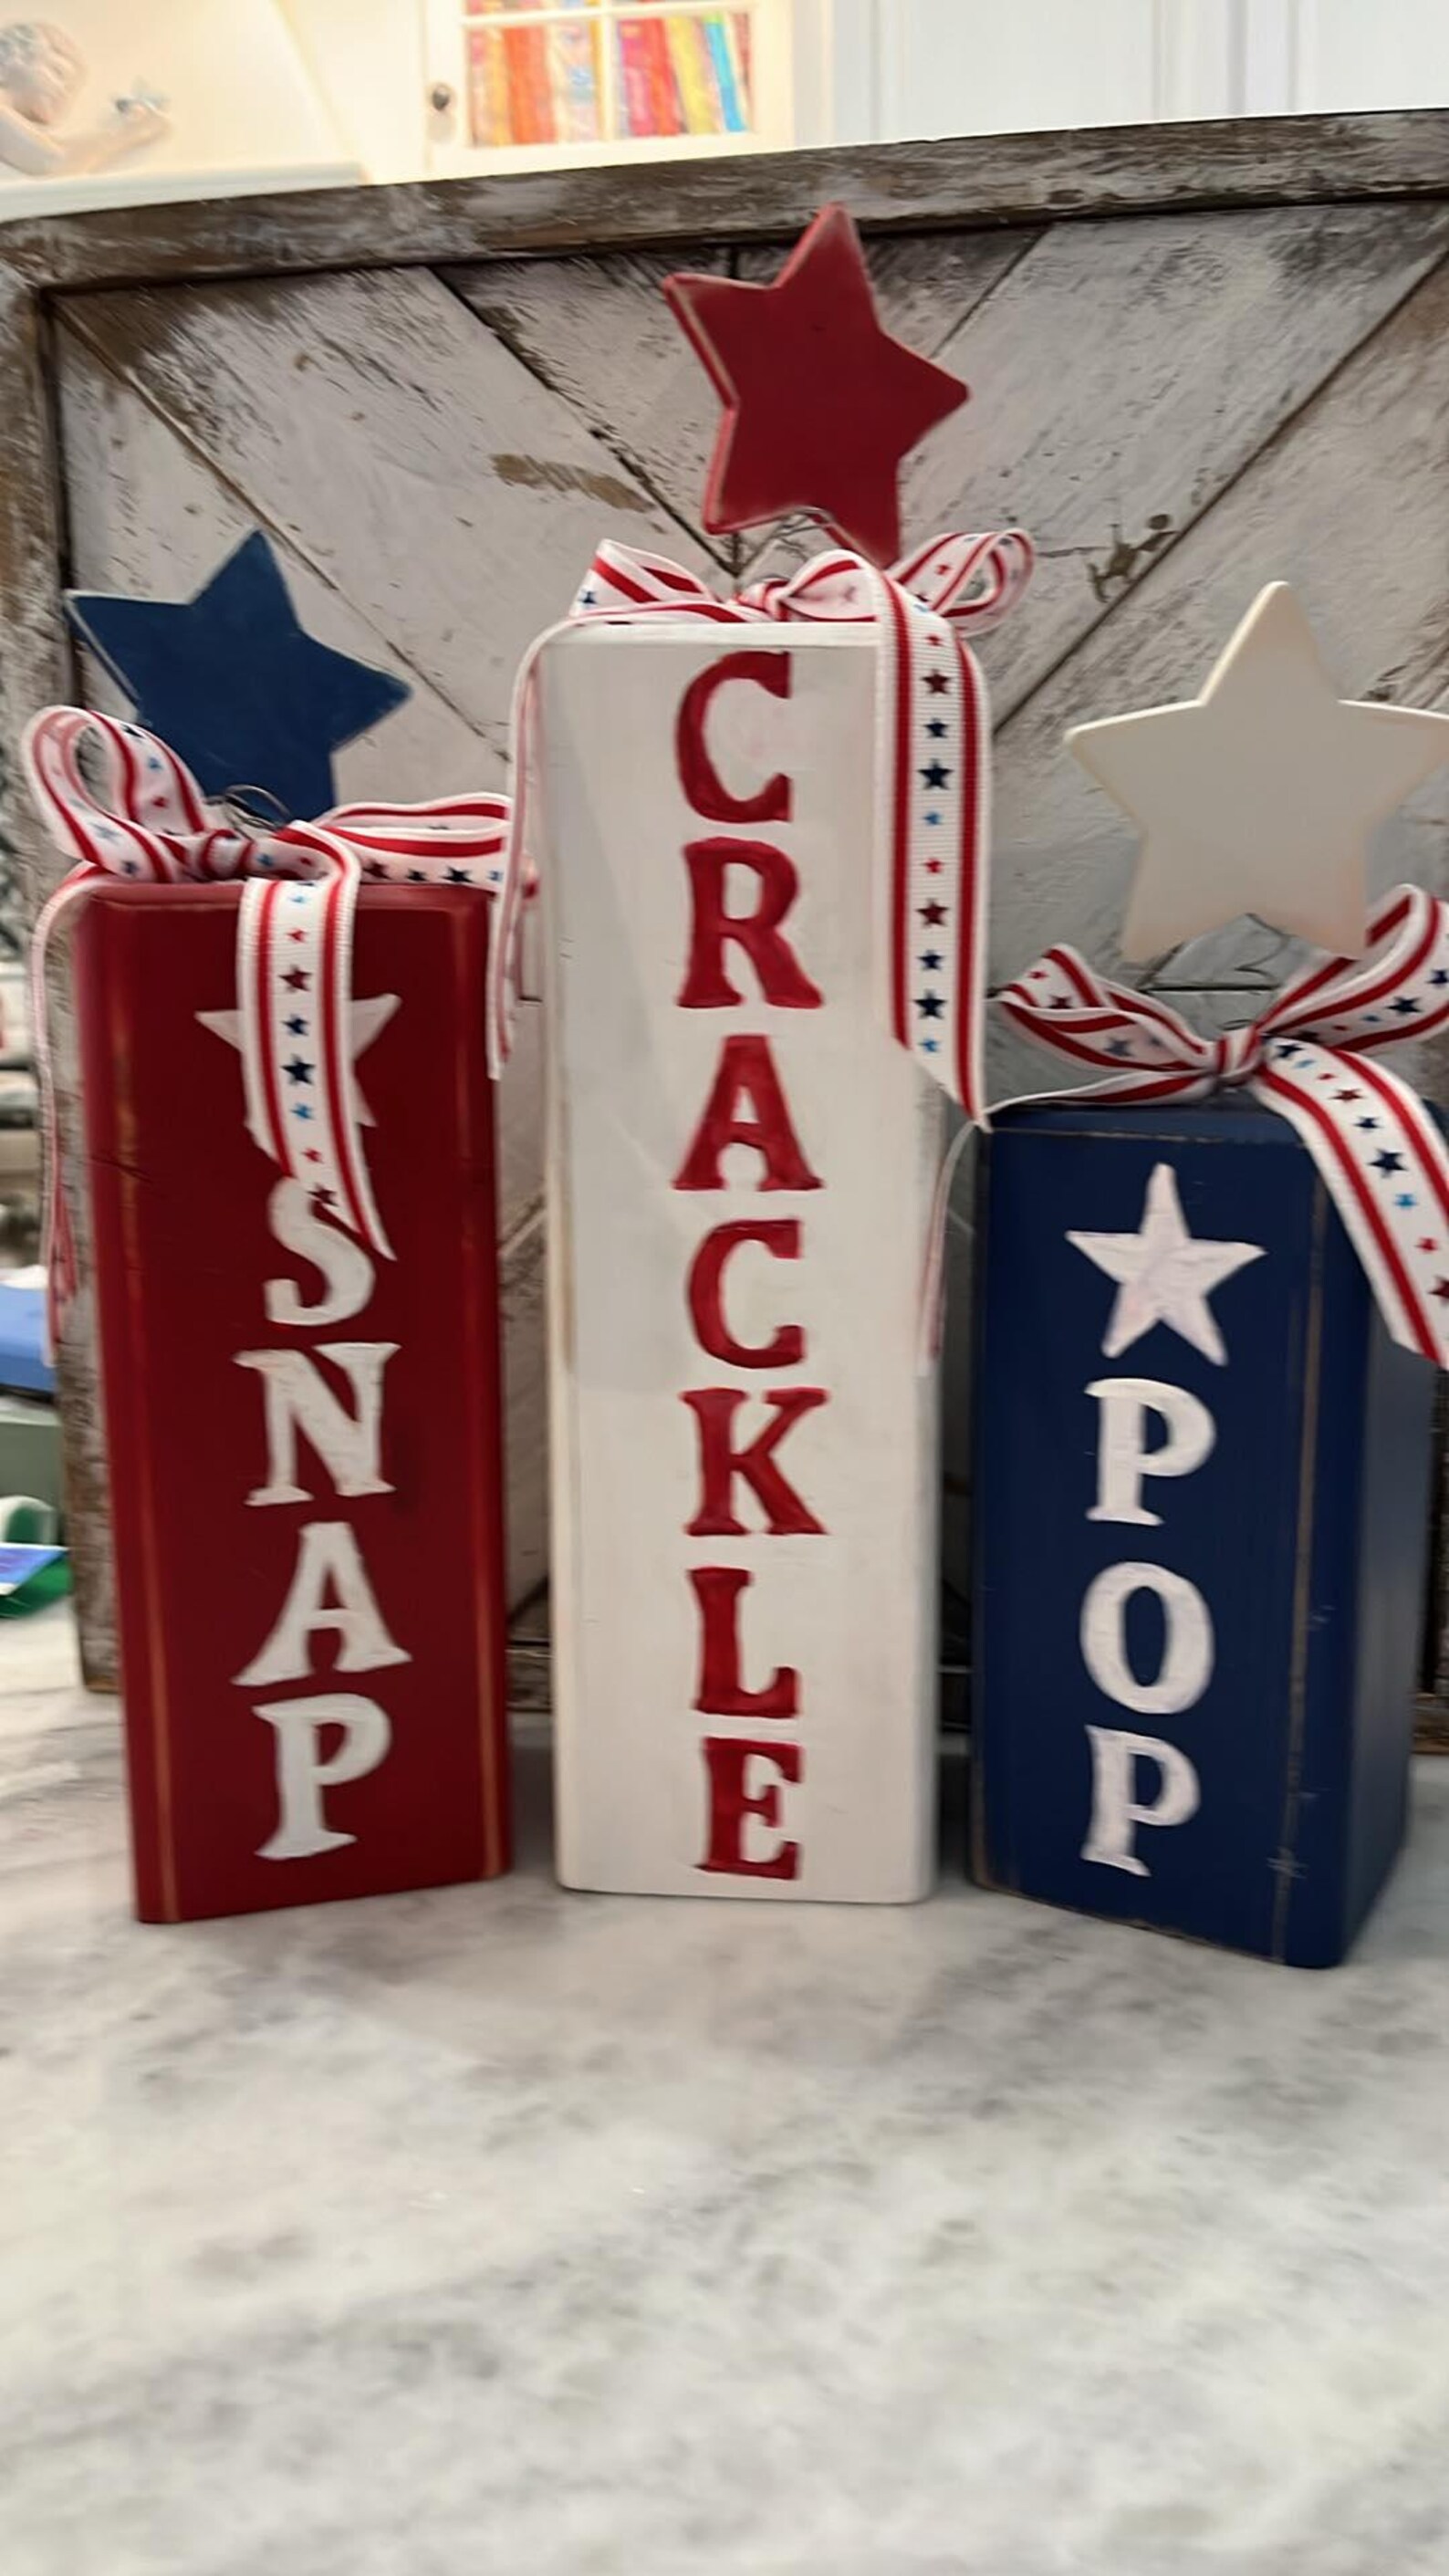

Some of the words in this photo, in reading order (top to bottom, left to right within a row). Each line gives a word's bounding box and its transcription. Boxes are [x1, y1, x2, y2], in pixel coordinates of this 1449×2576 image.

[234, 1173, 412, 1860] SNAP
[673, 651, 829, 1880] CRACKLE
[1081, 1377, 1216, 1877] POP
